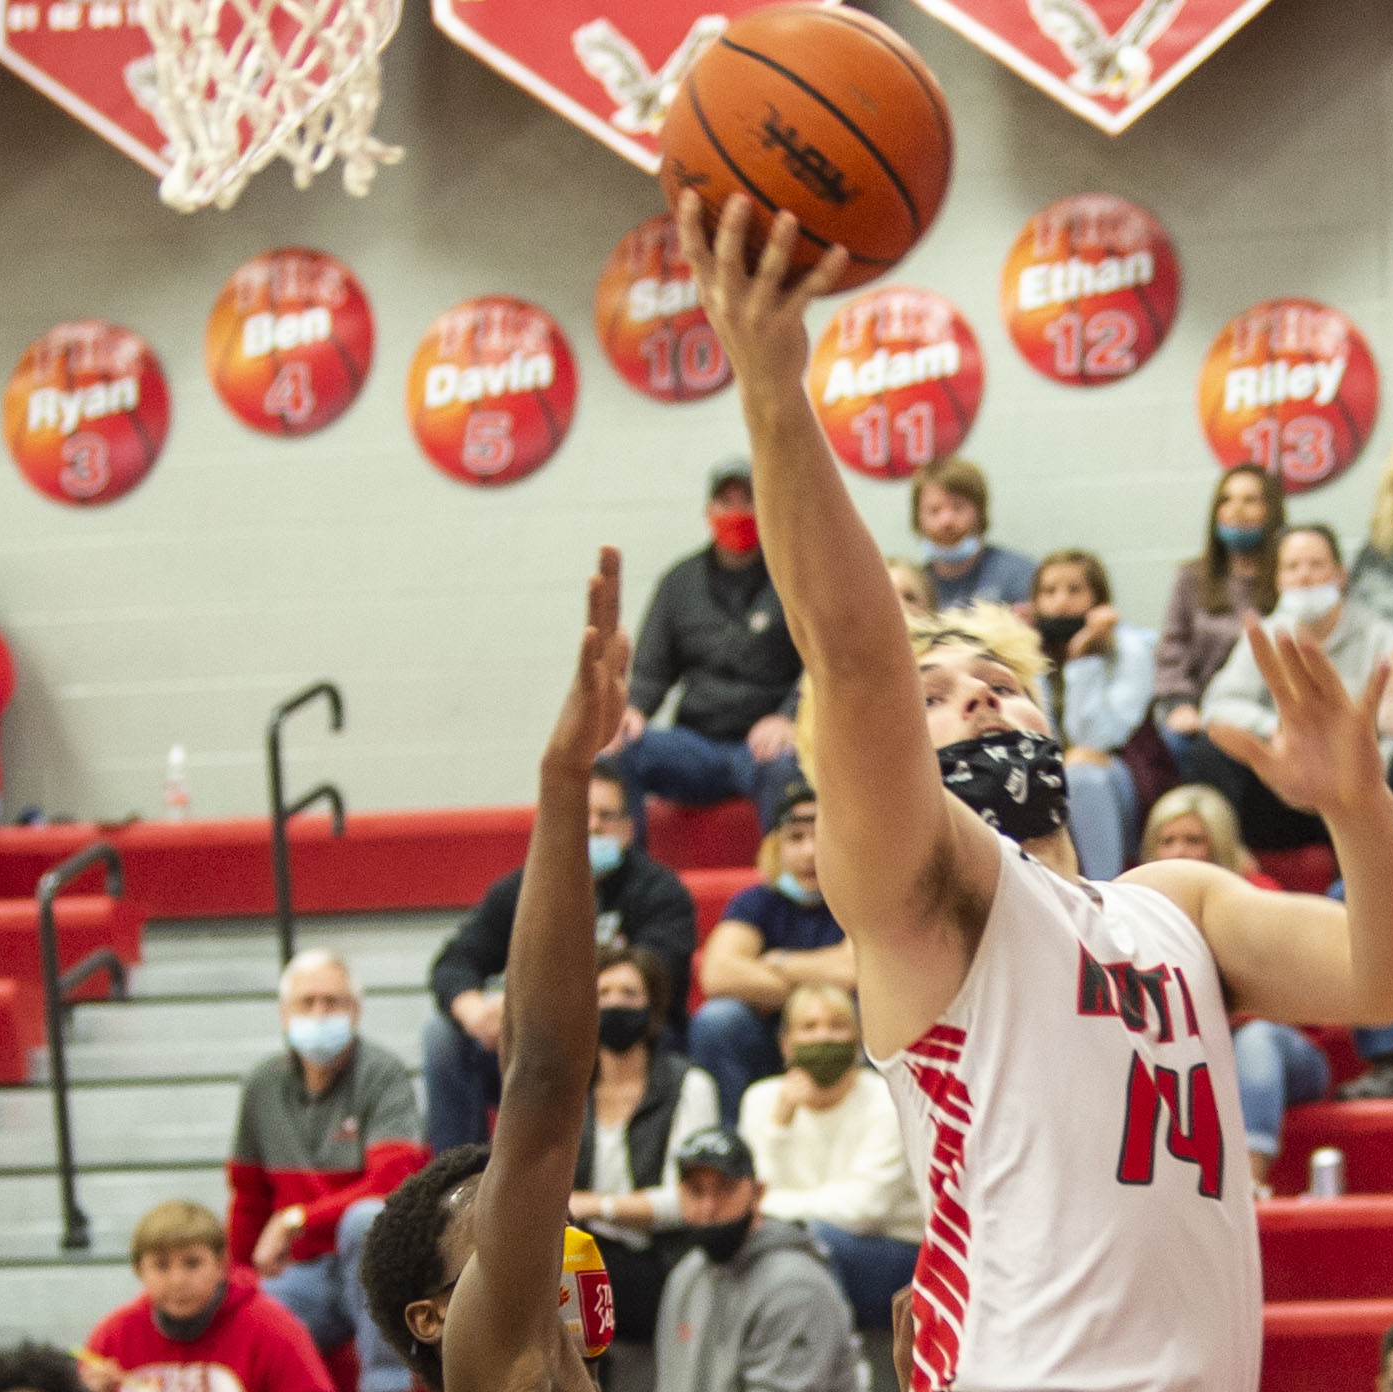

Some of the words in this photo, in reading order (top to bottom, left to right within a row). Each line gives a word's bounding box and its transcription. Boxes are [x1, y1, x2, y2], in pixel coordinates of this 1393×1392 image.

[1018, 249, 1154, 310] Ethan
[243, 307, 331, 358] Ben
[641, 325, 726, 390] 10
[1046, 310, 1138, 373] 12
[264, 362, 314, 424] 4
[424, 349, 553, 408] Davin
[823, 340, 959, 405] Adam
[1224, 356, 1346, 412] Riley
[27, 375, 138, 434] Ryan
[852, 403, 935, 466] 11
[59, 434, 108, 497] 3
[461, 410, 514, 474] 5
[1242, 416, 1335, 482] 13
[1116, 1048, 1224, 1200] 14
